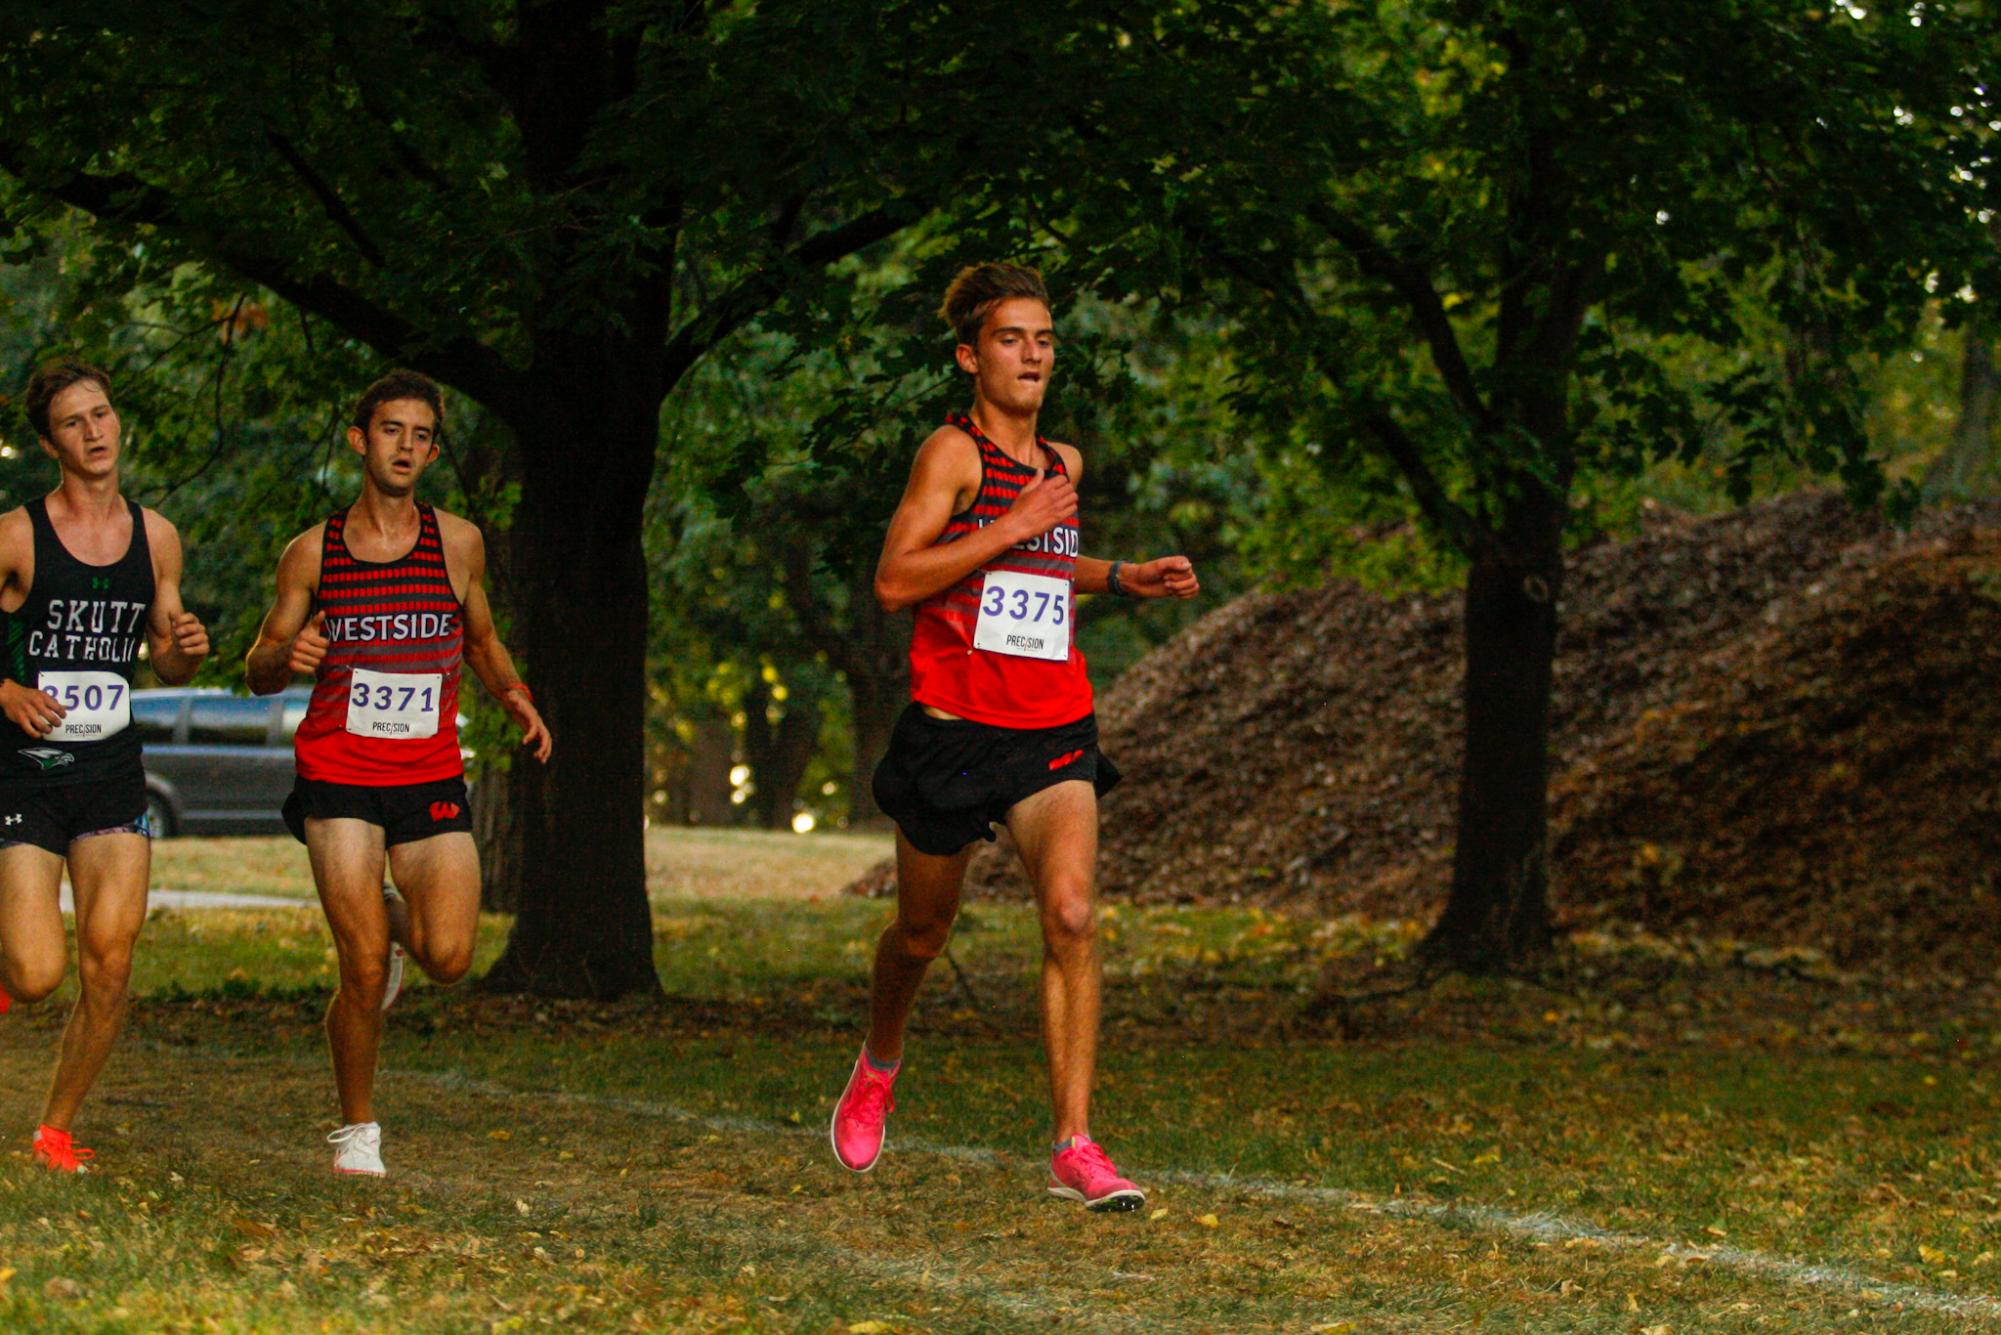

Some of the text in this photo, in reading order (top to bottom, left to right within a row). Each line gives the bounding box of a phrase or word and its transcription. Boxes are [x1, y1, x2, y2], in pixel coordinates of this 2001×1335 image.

[47, 599, 146, 633] SKUTT
[983, 586, 1064, 625] 3375
[325, 613, 453, 641] WESTSIDE
[352, 683, 434, 712] 3371
